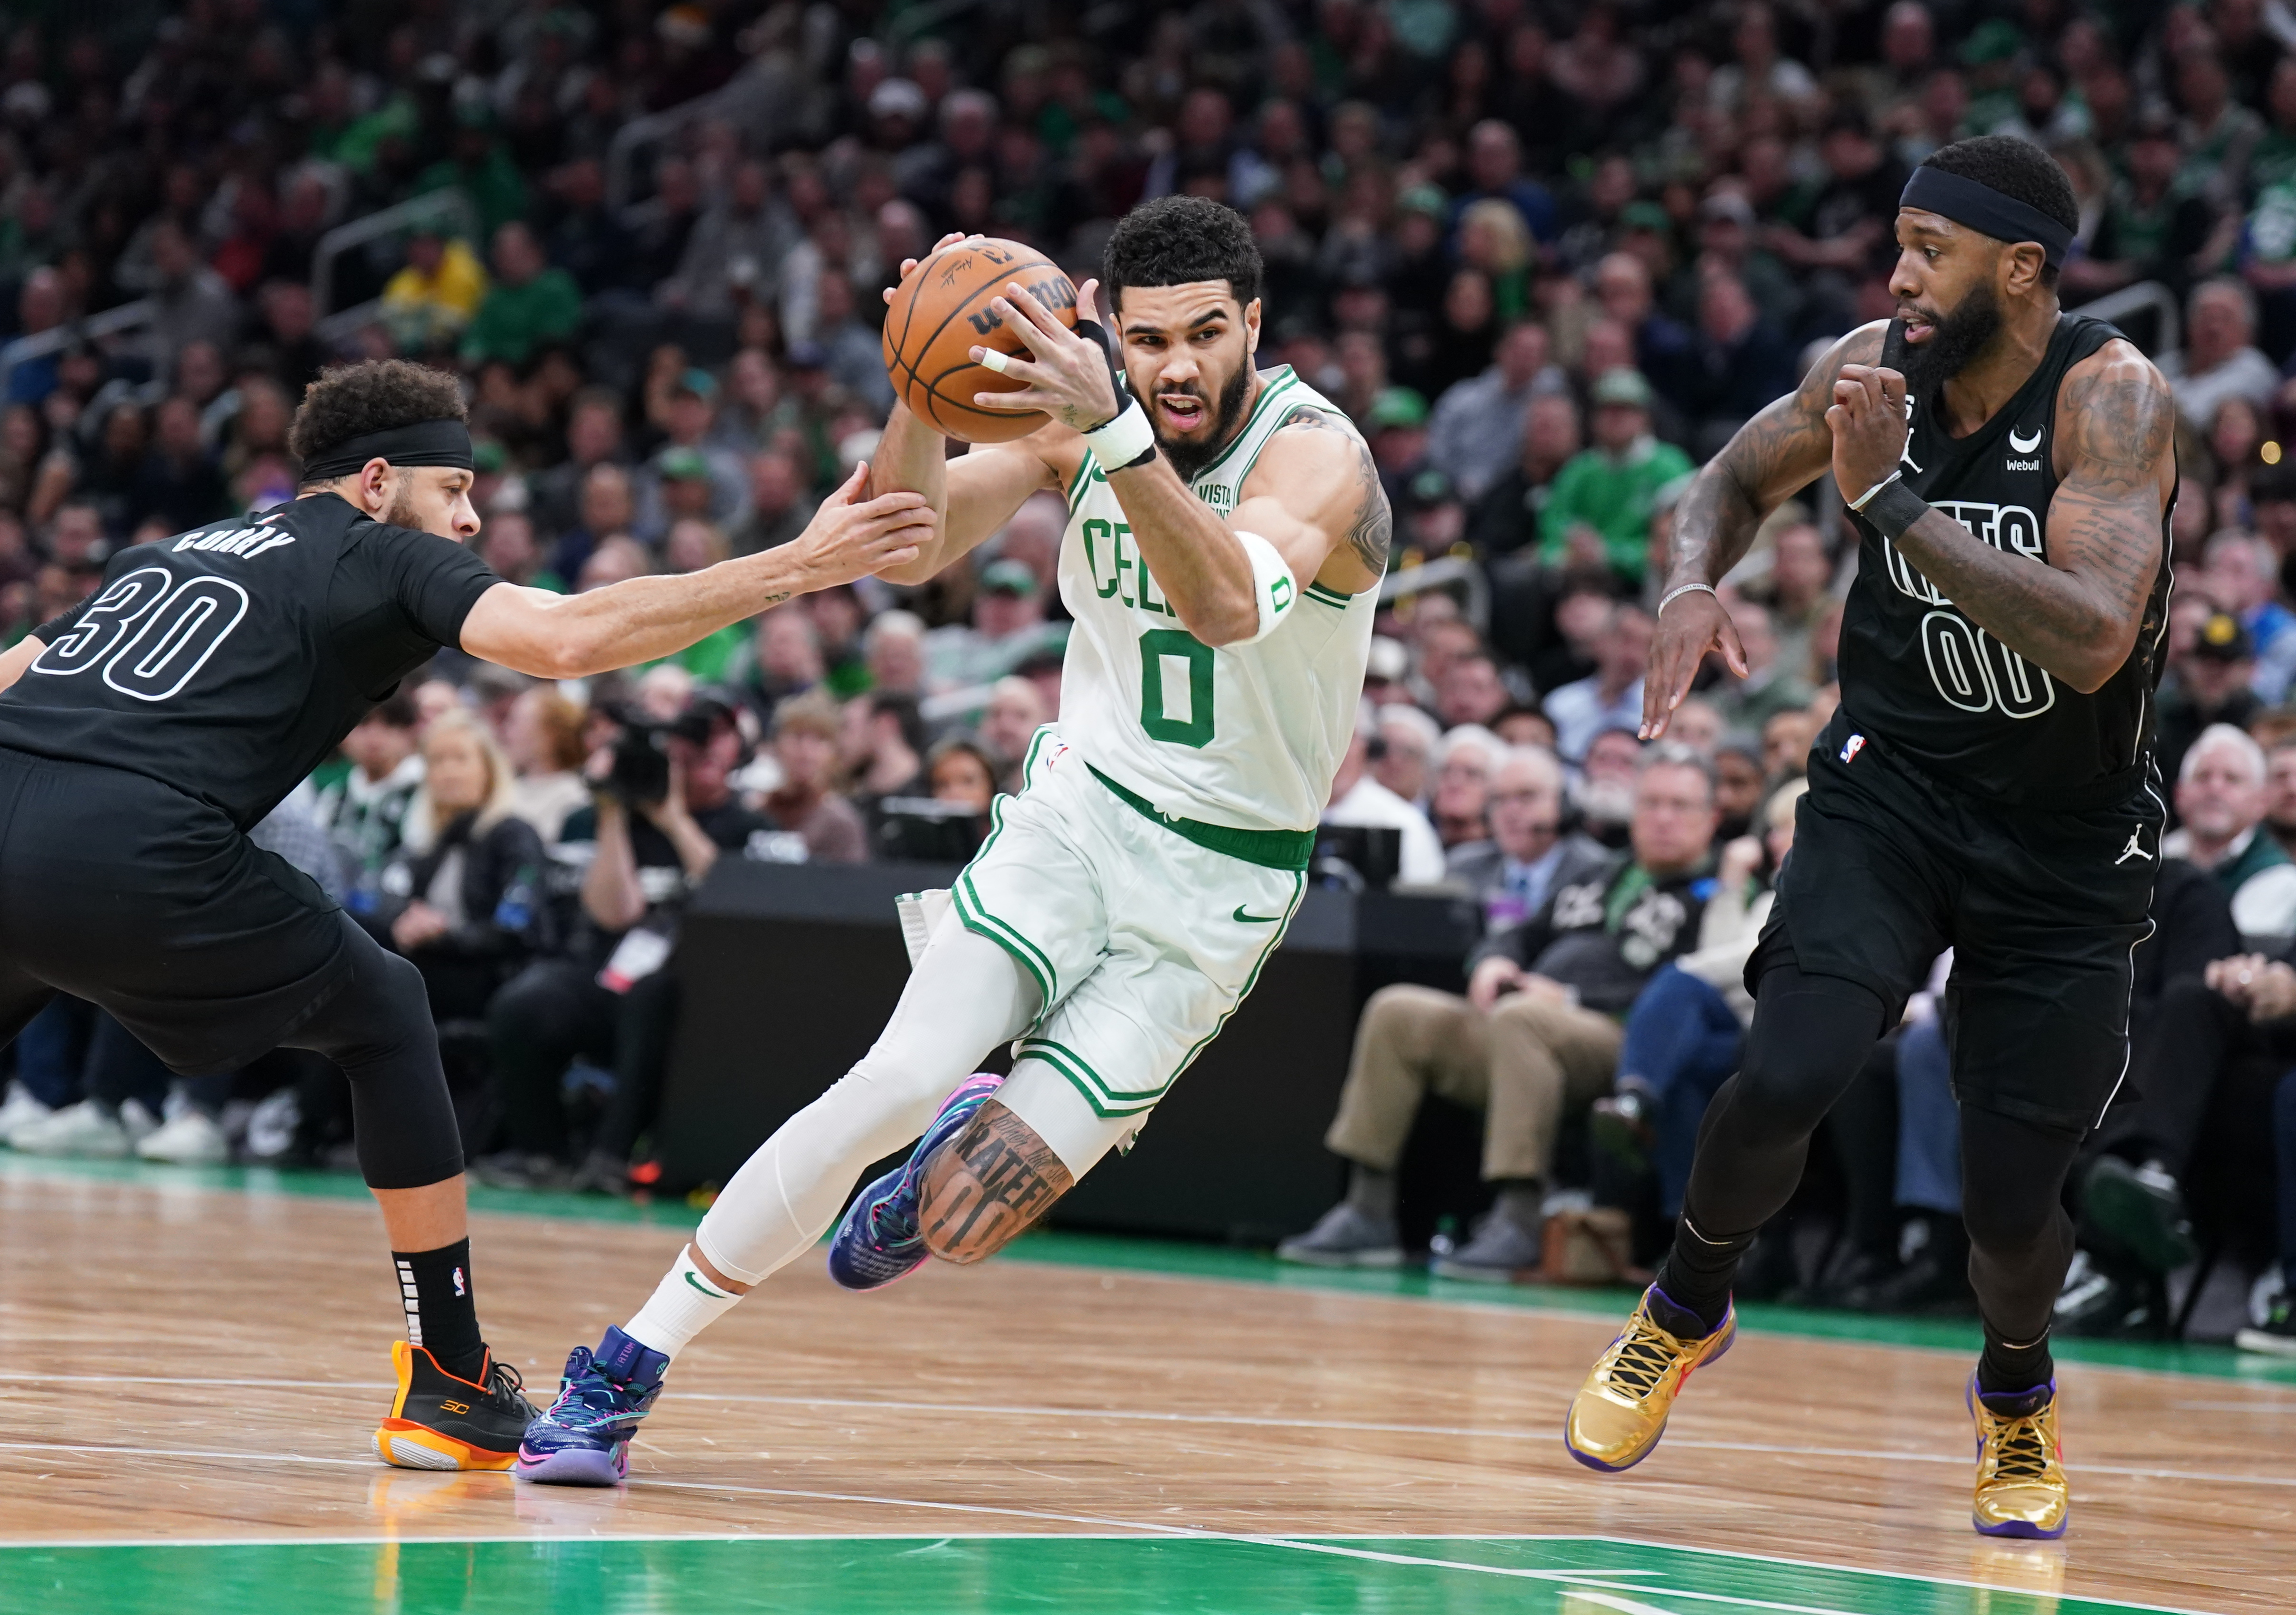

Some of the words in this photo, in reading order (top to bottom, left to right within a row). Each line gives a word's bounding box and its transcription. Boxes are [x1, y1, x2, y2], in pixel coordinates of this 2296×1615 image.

[967, 275, 1077, 335] Wiln
[2007, 459, 2039, 471] Webull
[1199, 484, 1230, 508] VISTA
[171, 526, 296, 559] CURRY
[30, 567, 249, 701] 30
[1921, 611, 2055, 719] 00
[1138, 629, 1215, 749] 0
[614, 1341, 636, 1368] TATUM
